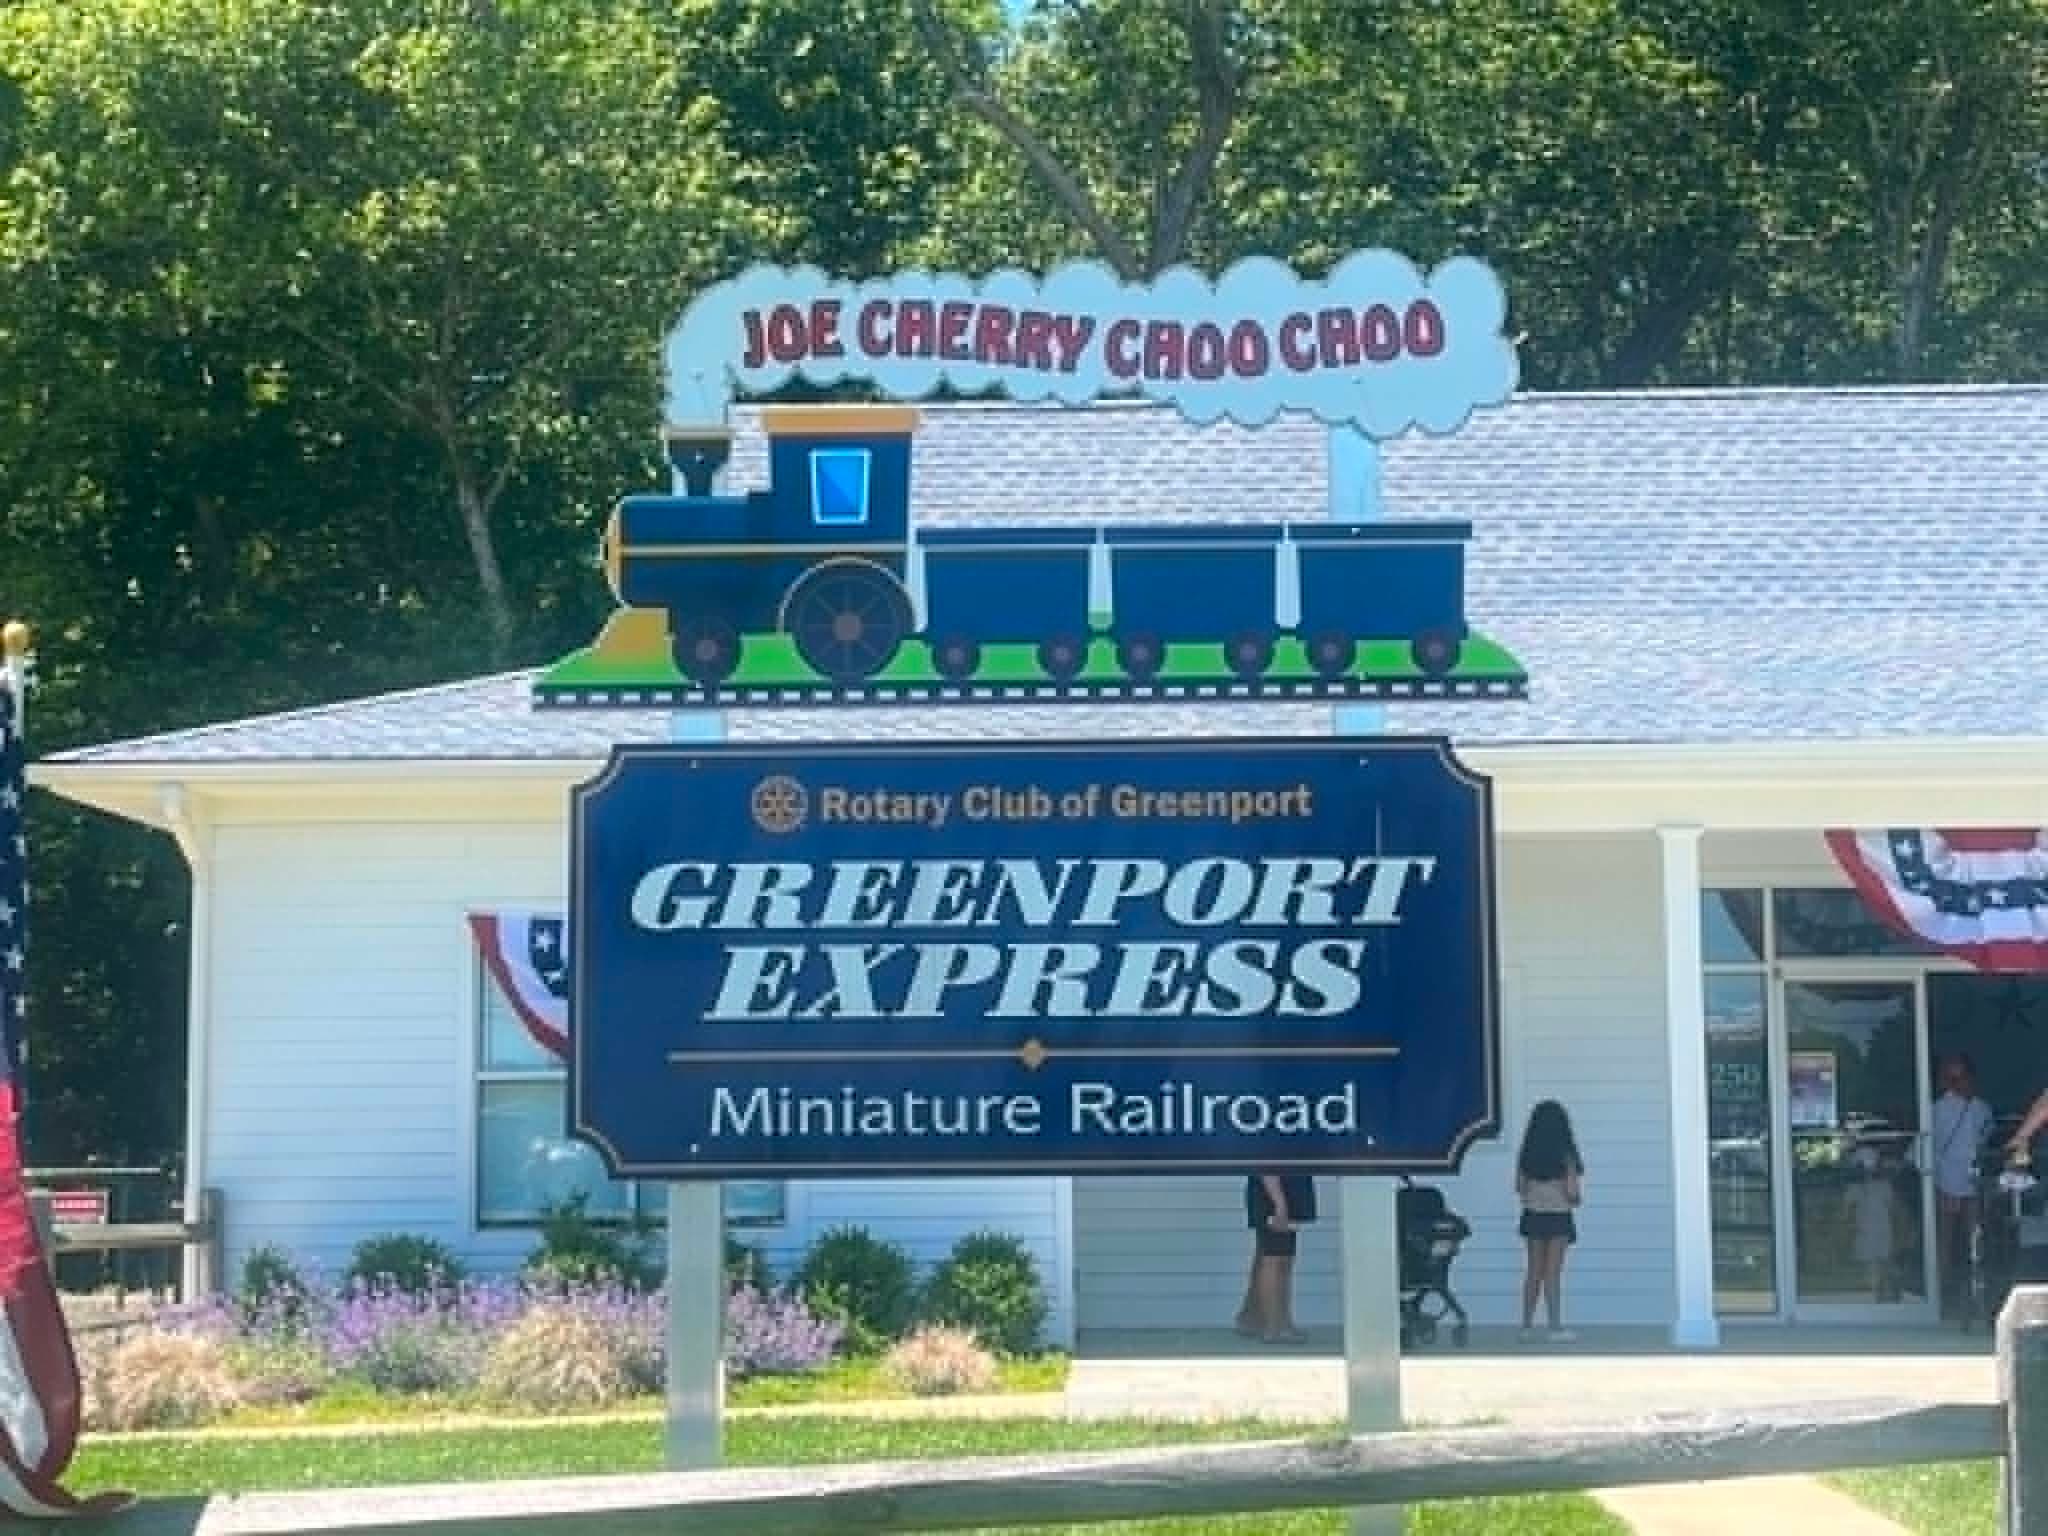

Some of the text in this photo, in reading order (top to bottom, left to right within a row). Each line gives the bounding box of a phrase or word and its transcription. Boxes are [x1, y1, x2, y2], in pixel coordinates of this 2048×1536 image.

[743, 300, 1445, 379] JOE CHERRY CHOO CHOO
[821, 784, 1313, 828] Rotary Club of Greenport
[630, 856, 1436, 931] GREENPORT
[703, 938, 1366, 1021] EXPRESS
[709, 1082, 1359, 1136] Miniature Railroad
